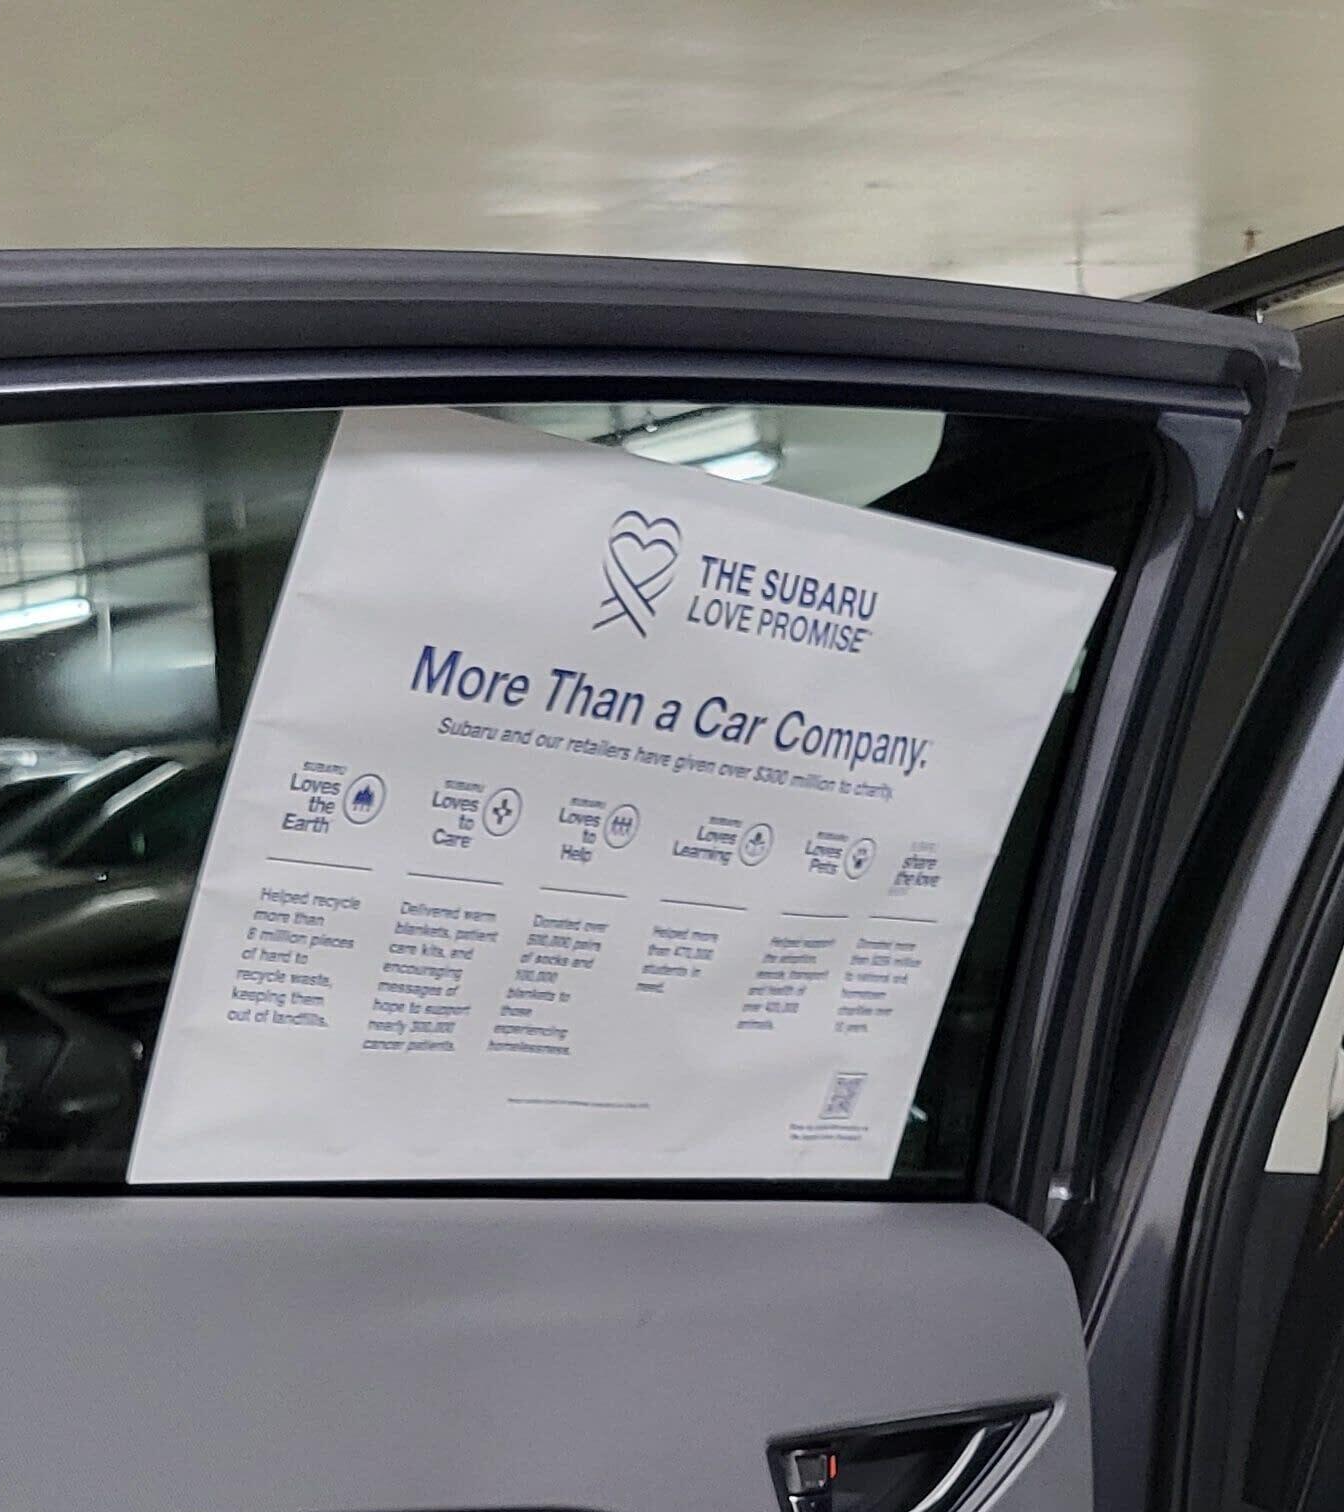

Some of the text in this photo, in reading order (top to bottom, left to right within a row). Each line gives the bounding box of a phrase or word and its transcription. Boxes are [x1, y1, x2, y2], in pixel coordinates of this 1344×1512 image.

[701, 555, 879, 622] THE SUBARU
[686, 594, 870, 654] LOVE PROMISE
[410, 644, 530, 707] More
[545, 666, 646, 726] Than
[654, 698, 683, 732] a
[693, 695, 769, 746] Car
[437, 716, 498, 741] Subaru
[500, 728, 533, 746] and
[534, 733, 564, 750] our
[566, 738, 633, 761] retailers
[633, 745, 671, 768] have
[671, 754, 716, 774] given
[717, 763, 753, 779] over
[753, 765, 790, 787] $300
[789, 773, 836, 794] million
[837, 779, 853, 796] to
[303, 760, 348, 776] SUBARU
[290, 772, 342, 796] Loves
[308, 796, 336, 816] the
[432, 791, 480, 813] Loves
[282, 812, 330, 835] Earth
[458, 814, 475, 832] to
[558, 806, 602, 829] Loves
[432, 828, 473, 849] Care
[582, 828, 598, 845] to
[697, 826, 738, 846] Loves
[560, 843, 593, 865] Help
[672, 839, 733, 867] Learning
[805, 840, 844, 859] Loves
[808, 857, 840, 876] Pets
[260, 887, 361, 912] Helped recycle
[253, 910, 325, 927] more than
[400, 901, 497, 922] Delivered warm
[260, 929, 308, 944] million
[309, 934, 355, 949] pieces
[454, 928, 499, 943] patient
[241, 947, 309, 966] of hard to
[389, 943, 418, 955] care
[450, 948, 475, 961] and
[236, 969, 287, 985] recycle
[383, 962, 464, 982] encouraging
[232, 986, 325, 1008] keeping them
[377, 981, 459, 999] messages of
[227, 1009, 252, 1023] out
[254, 1009, 270, 1024] of
[373, 998, 405, 1015] hope
[409, 1001, 422, 1014] to
